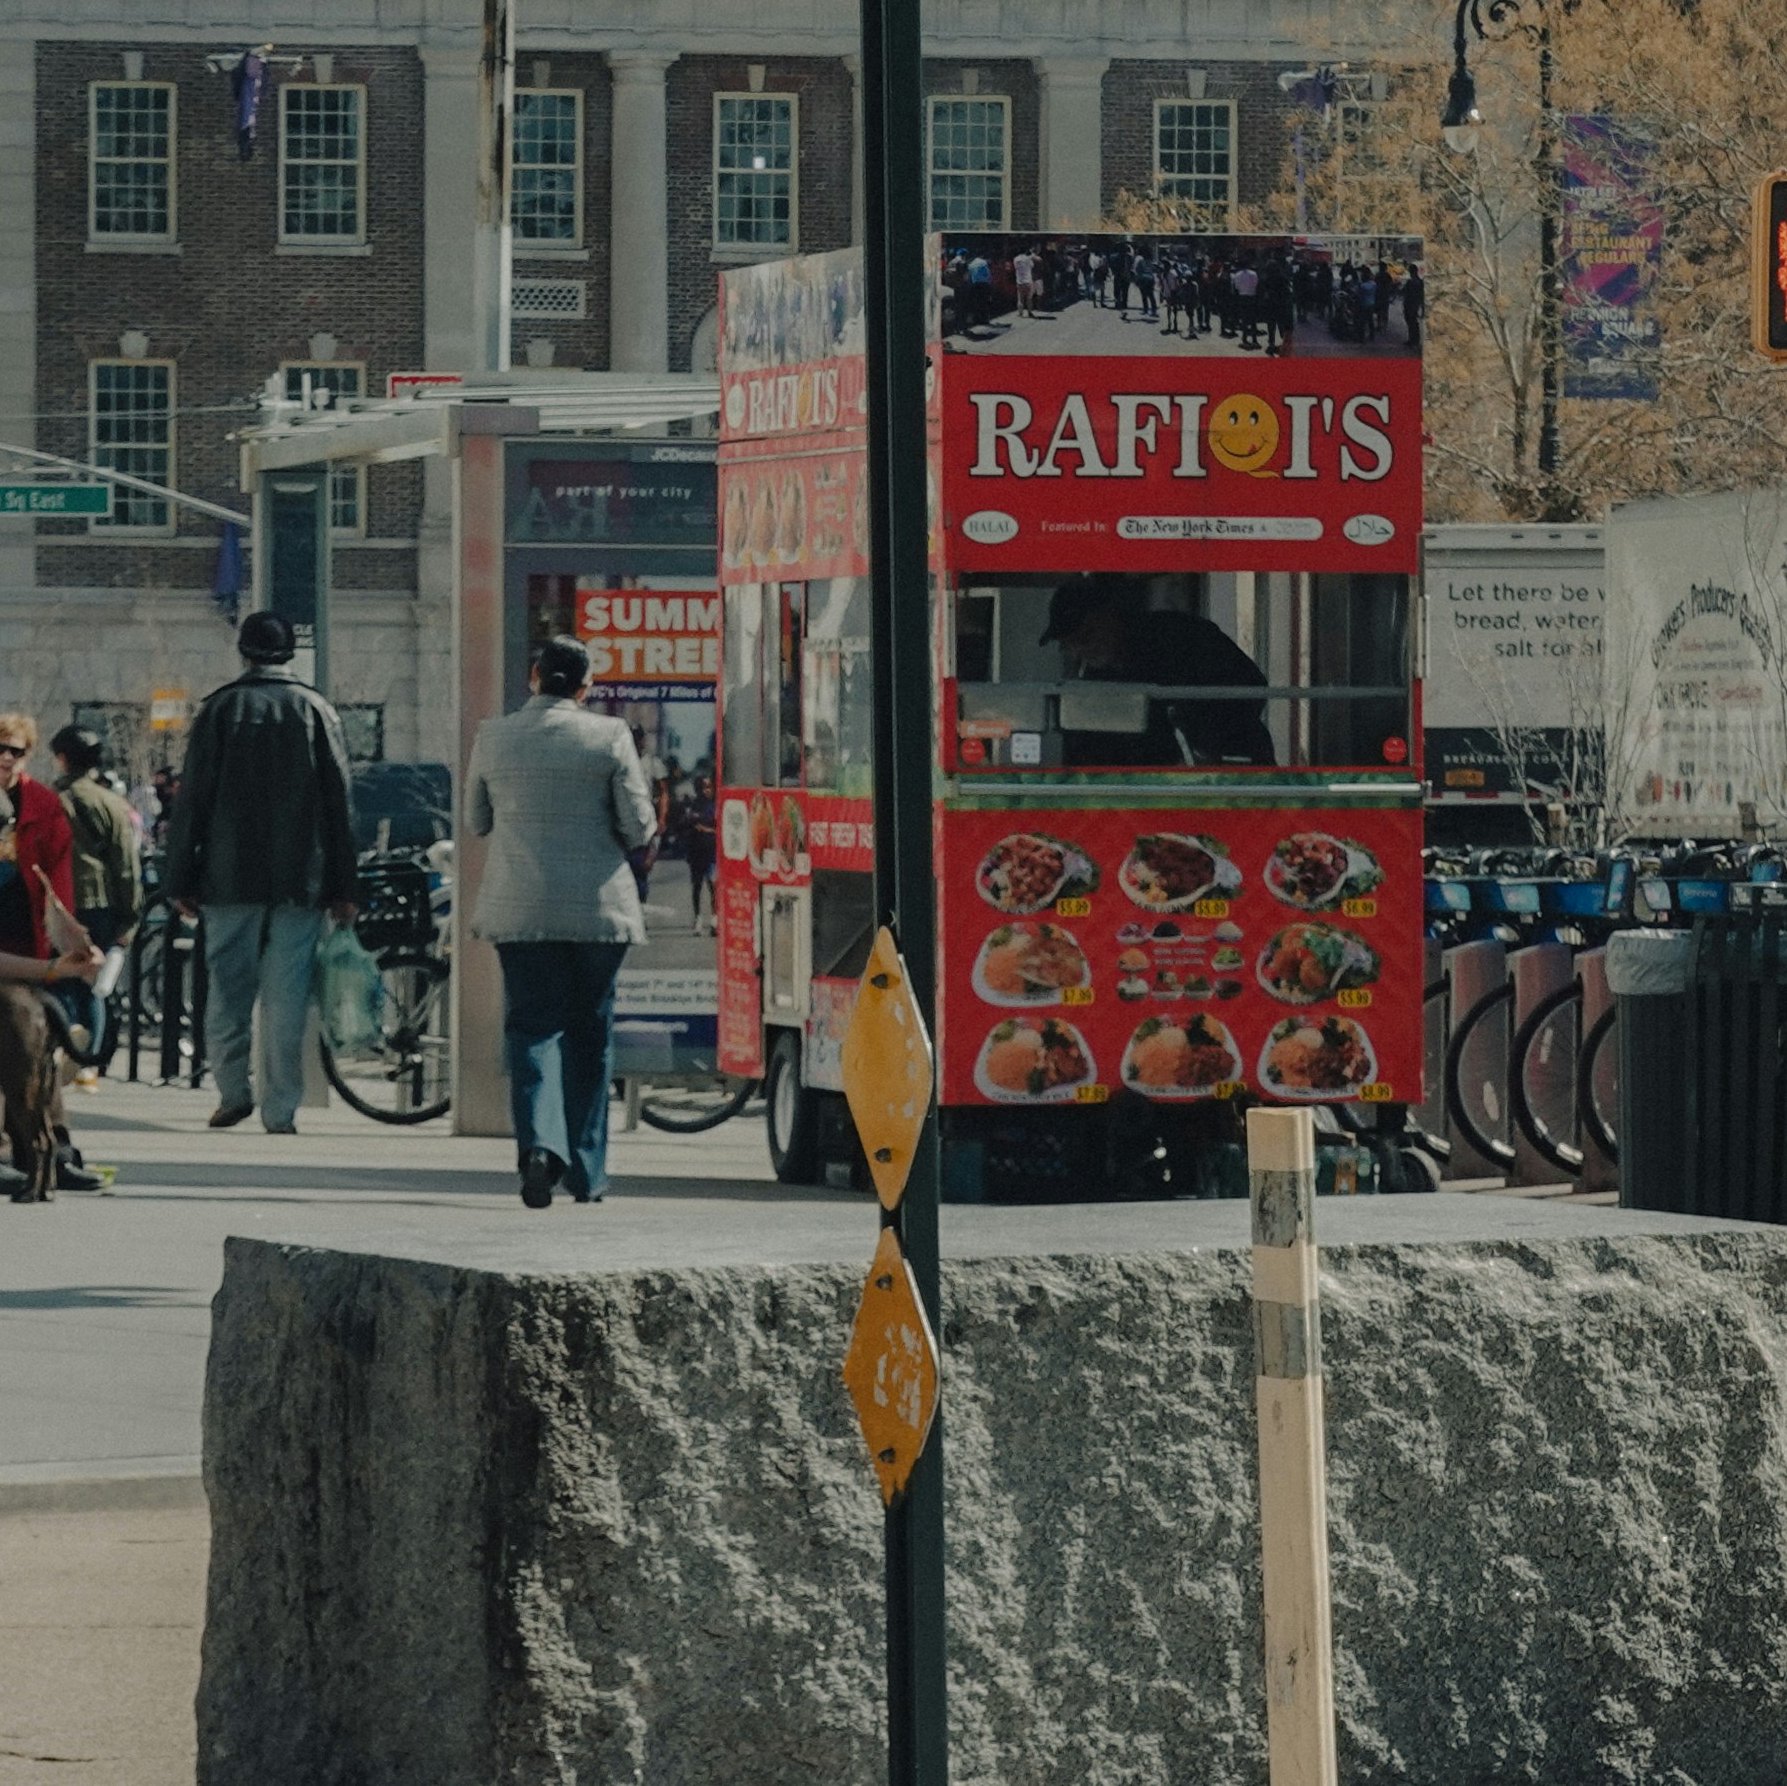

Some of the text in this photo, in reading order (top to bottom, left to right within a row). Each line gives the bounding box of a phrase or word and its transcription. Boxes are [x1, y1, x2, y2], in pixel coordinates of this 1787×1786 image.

[5, 490, 27, 509] Sq
[29, 491, 65, 508] East
[556, 484, 692, 499] part of your city
[969, 520, 1010, 533] HALAL
[1041, 520, 1090, 532] Featured
[1125, 519, 1149, 534] The
[1153, 519, 1179, 533] New
[1182, 520, 1213, 537] York
[1216, 519, 1255, 534] Times
[1348, 517, 1391, 538] حلال
[1448, 583, 1485, 601] Let
[1493, 582, 1552, 602] there
[1562, 583, 1589, 602] be
[1455, 612, 1527, 632] bread,
[1495, 639, 1533, 658] salt
[617, 686, 659, 700] Original
[661, 686, 670, 698] 7
[671, 686, 699, 698] Miles
[701, 686, 714, 698] of
